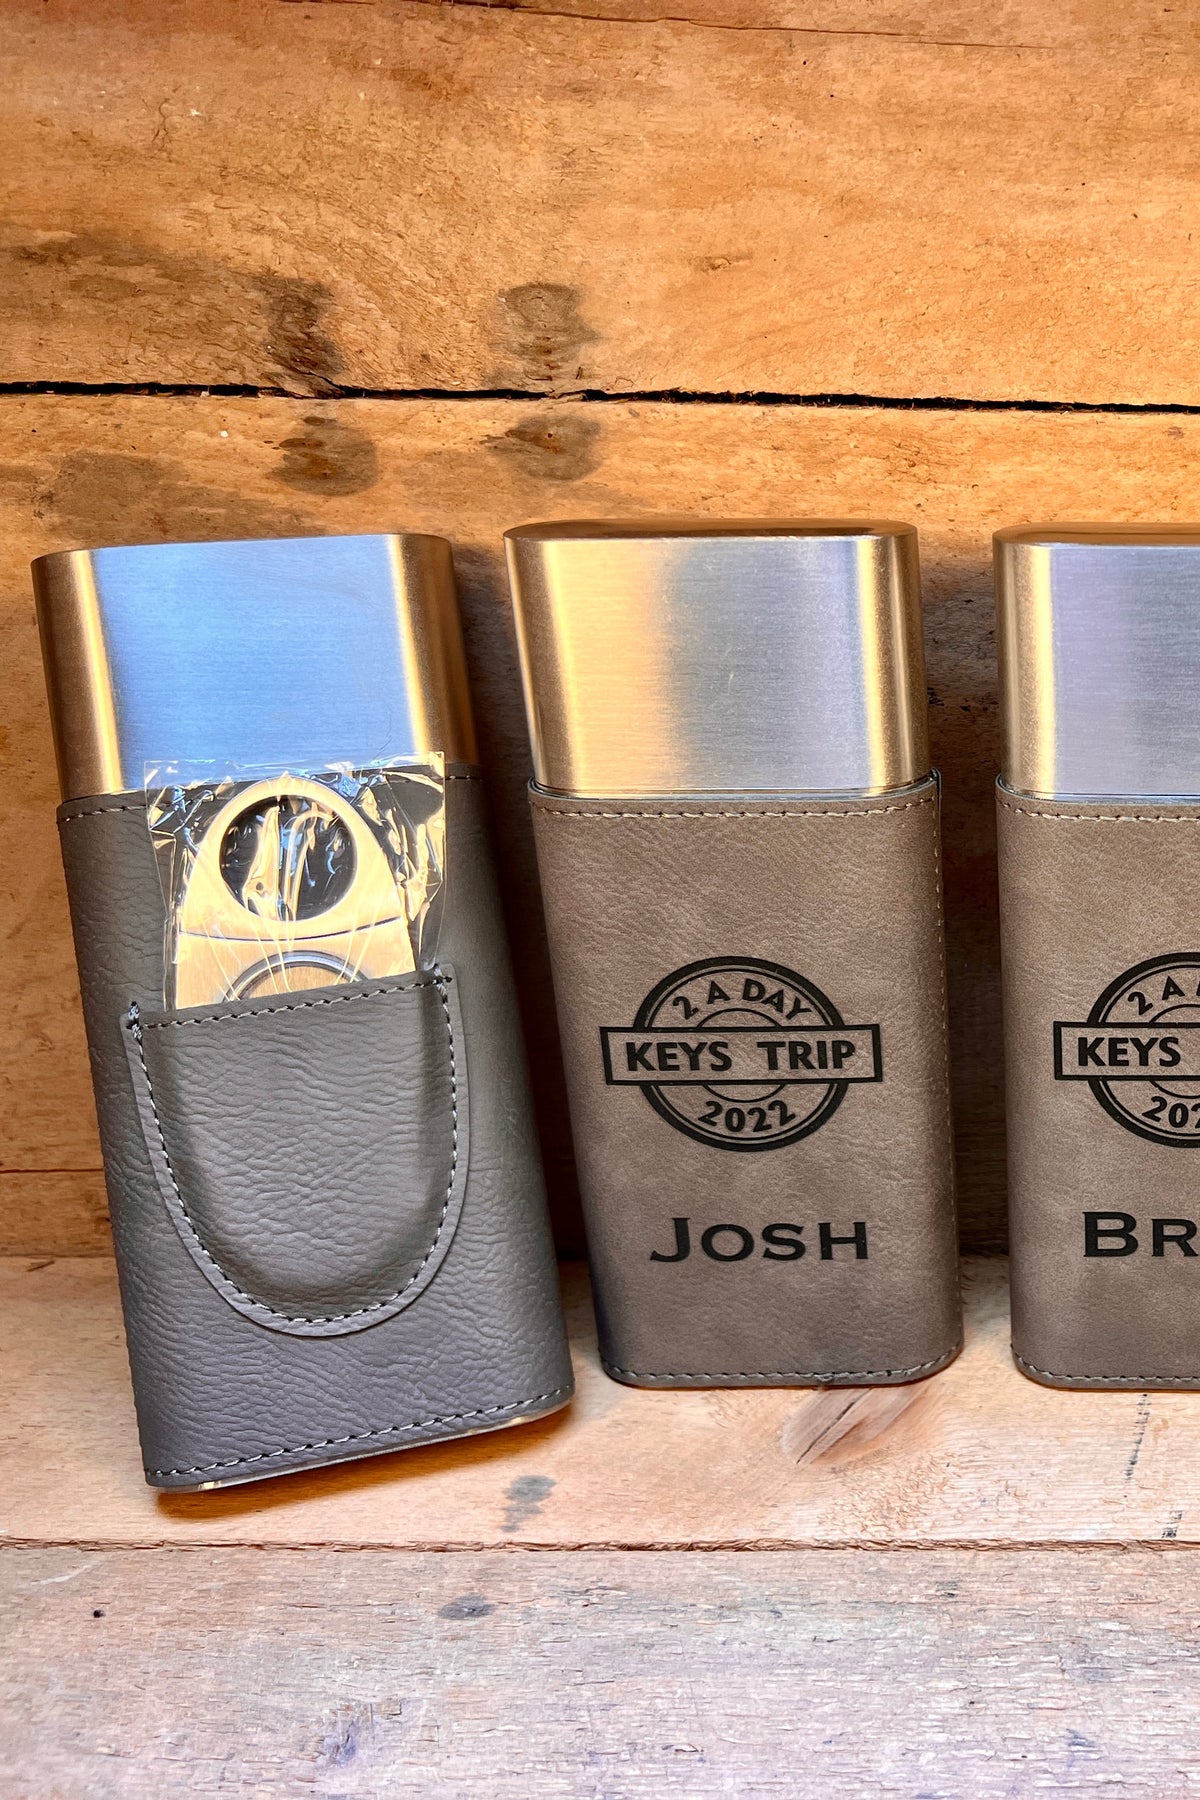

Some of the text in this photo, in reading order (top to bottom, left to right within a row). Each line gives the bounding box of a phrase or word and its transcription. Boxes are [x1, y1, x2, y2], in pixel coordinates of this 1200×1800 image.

[673, 978, 812, 1021] 2 A DAY
[1128, 991, 1154, 1016] 2
[1161, 975, 1186, 1001] A
[625, 1040, 856, 1071] KEYS TRIP
[1077, 1036, 1182, 1067] KEYS
[698, 1100, 796, 1133] 2022
